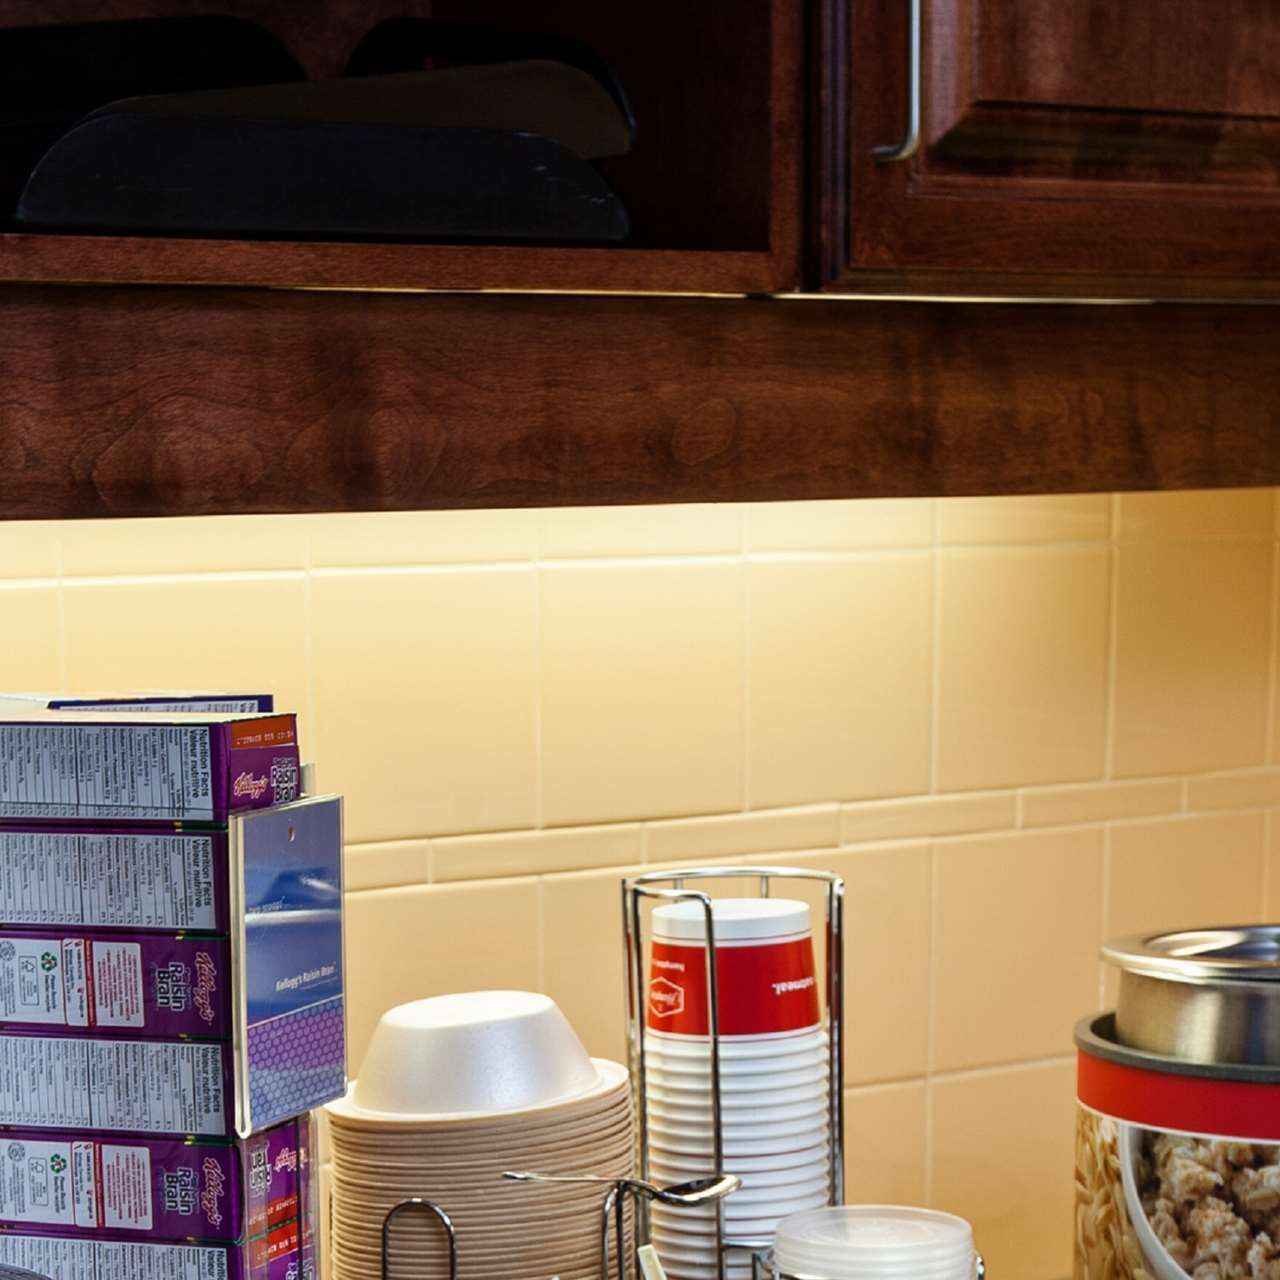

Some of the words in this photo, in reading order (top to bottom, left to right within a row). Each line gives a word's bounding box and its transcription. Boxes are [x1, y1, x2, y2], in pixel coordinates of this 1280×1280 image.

[189, 729, 198, 758] Valeur
[200, 729, 209, 769] Nutrition
[191, 760, 200, 798] nutritive
[201, 771, 210, 797] Facts
[192, 838, 201, 868] Valeur
[201, 838, 211, 879] Nutrition
[193, 870, 202, 908] nutritive
[203, 881, 212, 907] Facts
[156, 968, 171, 1008] Bran
[169, 962, 186, 1011] Raisin
[193, 952, 217, 1021] Kellogg's
[211, 1047, 220, 1086] Nutrition
[212, 1088, 221, 1113] Facts
[164, 1172, 178, 1210] Bran
[177, 1167, 195, 1215] Raisin
[201, 1157, 226, 1225] Kellogg's
